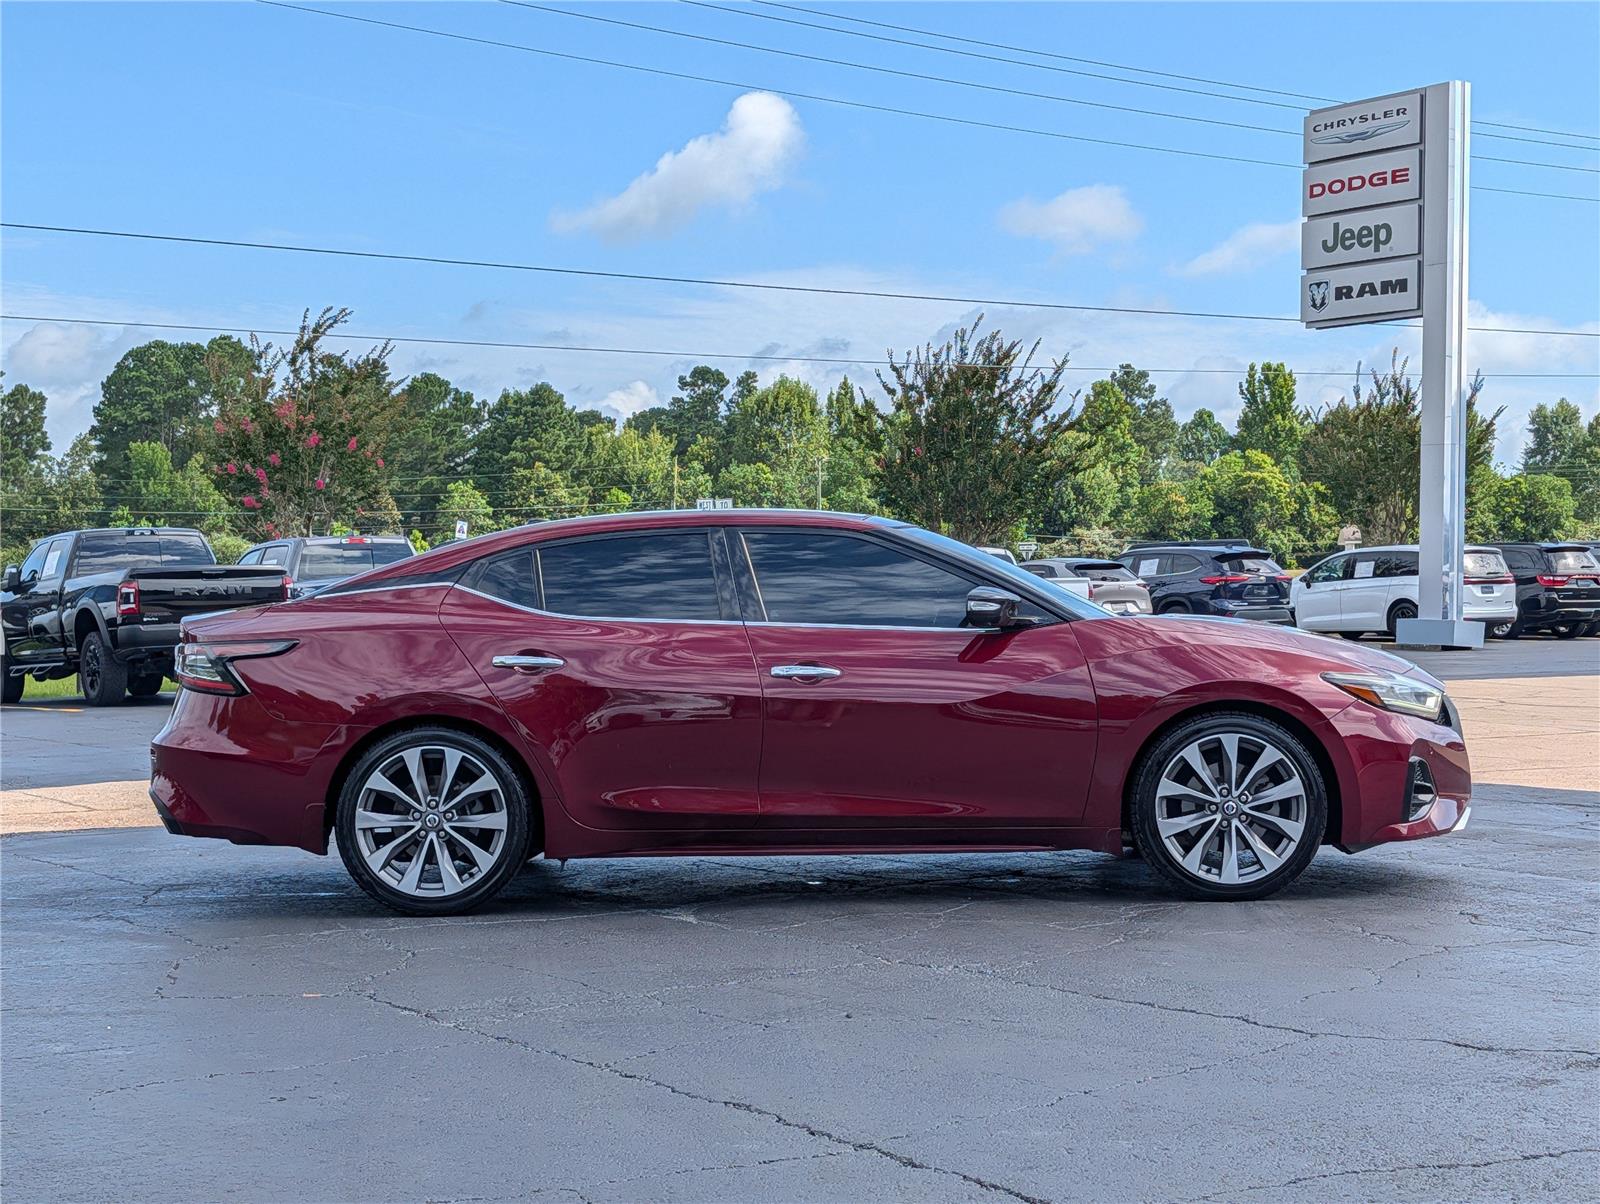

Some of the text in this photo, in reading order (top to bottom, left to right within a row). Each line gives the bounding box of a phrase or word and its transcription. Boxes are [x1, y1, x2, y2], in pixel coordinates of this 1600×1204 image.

[1312, 107, 1408, 133] CHRYSLER
[1309, 167, 1410, 199] DODGE
[1321, 221, 1393, 253] Jeep
[1334, 278, 1408, 301] RAM
[173, 584, 253, 597] RAM
